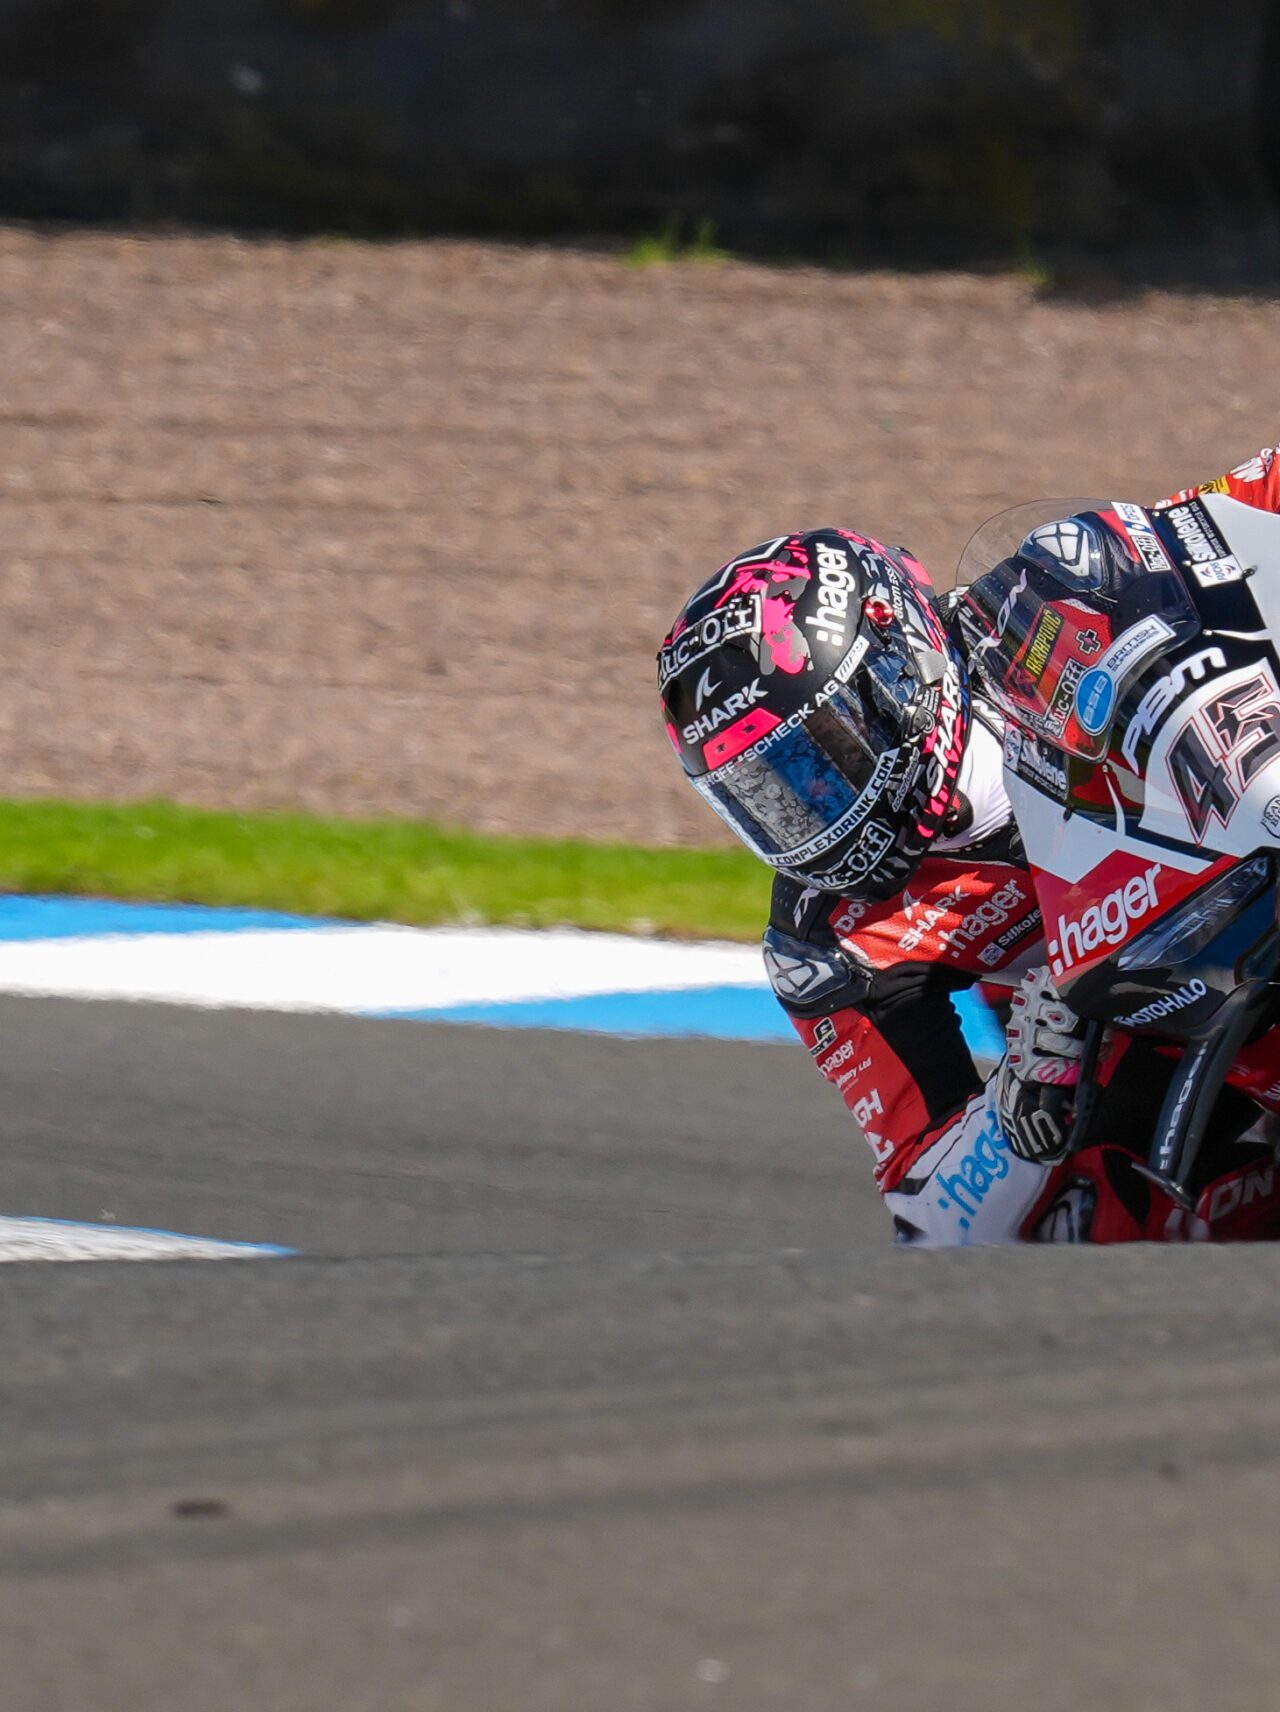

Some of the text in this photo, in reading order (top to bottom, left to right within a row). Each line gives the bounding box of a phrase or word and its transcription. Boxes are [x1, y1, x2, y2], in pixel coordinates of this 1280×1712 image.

[682, 677, 769, 745] SHARK
[814, 679, 840, 708] AG
[1083, 675, 1108, 725] BSB
[898, 885, 971, 952] SHARK
